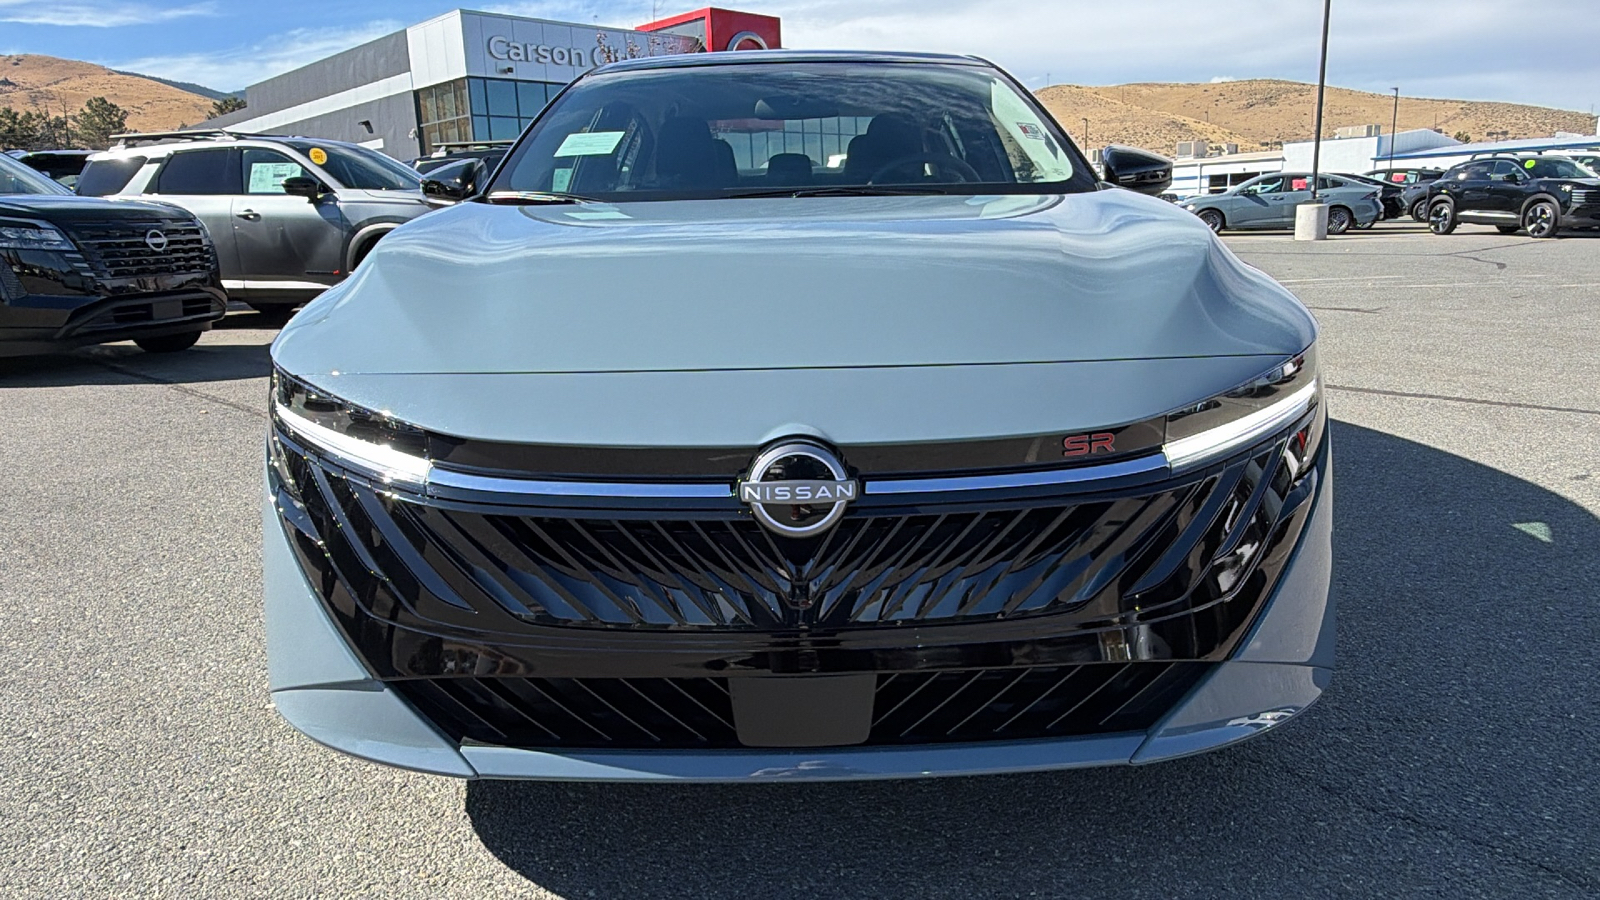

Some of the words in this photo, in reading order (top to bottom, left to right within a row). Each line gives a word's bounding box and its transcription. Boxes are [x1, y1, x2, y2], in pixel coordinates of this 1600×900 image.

[488, 35, 585, 66] Carson
[1063, 432, 1115, 456] SR
[744, 484, 853, 500] NISSAN
